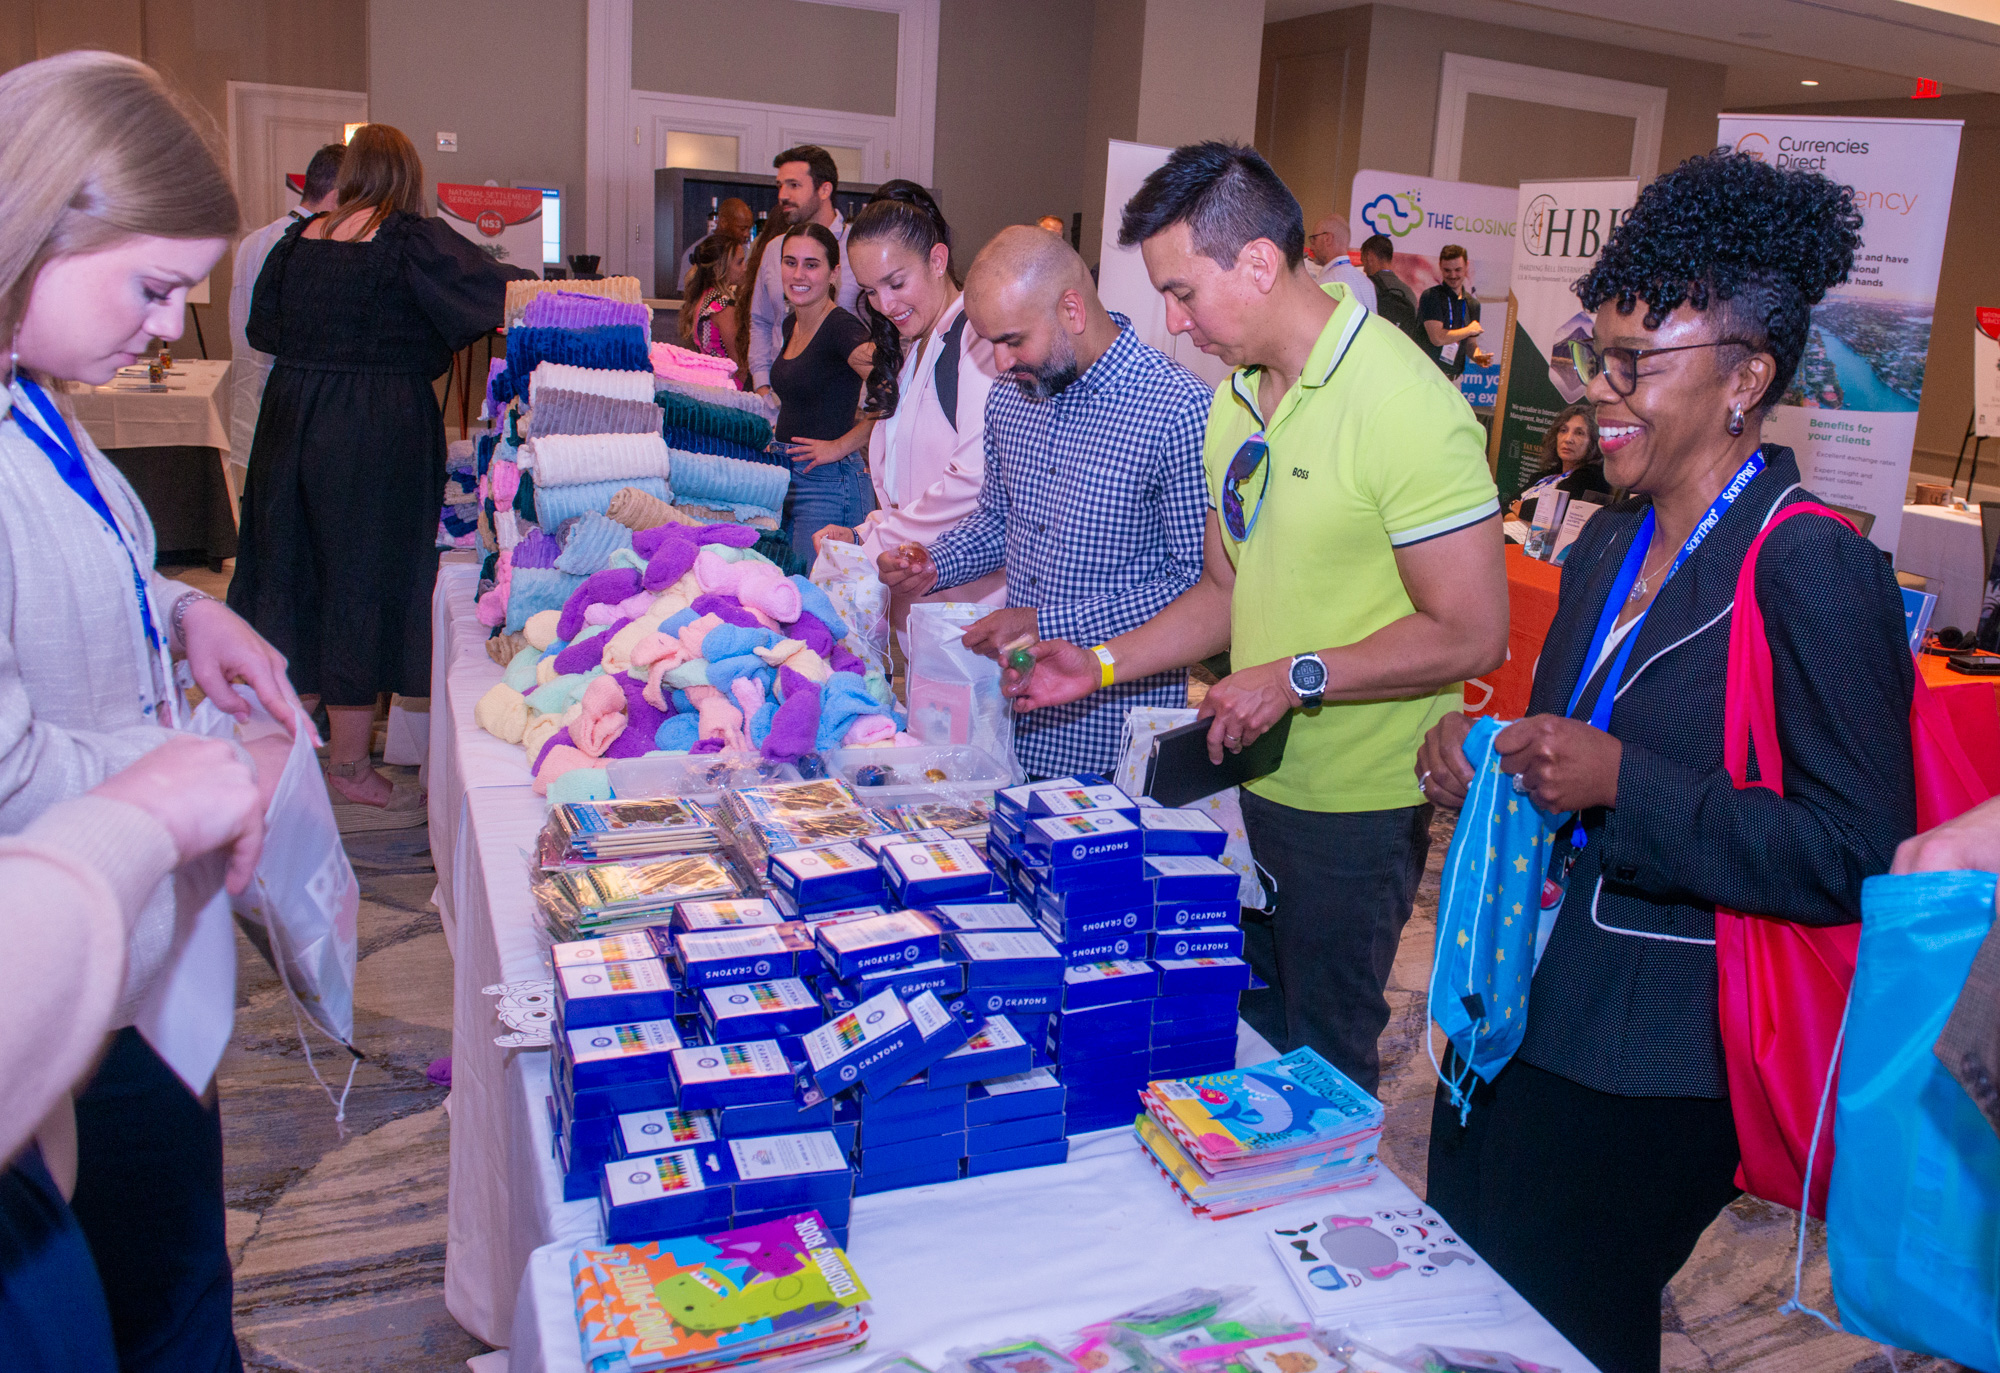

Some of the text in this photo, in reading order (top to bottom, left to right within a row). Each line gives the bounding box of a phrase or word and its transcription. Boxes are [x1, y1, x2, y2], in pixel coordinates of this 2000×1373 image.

[1779, 136, 1869, 154] Currencies
[1776, 153, 1827, 170] Direct
[448, 188, 484, 198] NATIONAL
[486, 190, 532, 200] SETTLEMENT
[448, 196, 482, 205] SERVICES
[484, 197, 513, 207] SUMMIT
[1852, 190, 1918, 215] ency
[481, 219, 501, 229] NS3
[1865, 253, 1883, 262] and
[1885, 254, 1909, 264] have
[1855, 278, 1884, 287] hands
[1460, 374, 1500, 389] orm yo
[1809, 418, 1873, 433] Benefits for
[1808, 432, 1871, 446] your clients
[1816, 450, 1896, 467] Excellent exchange rates
[1292, 467, 1309, 480] BOSS
[1814, 466, 1836, 476] Expert
[1837, 469, 1859, 480] insight
[1812, 475, 1863, 487] market updates
[1088, 841, 1130, 855] CRAYONS
[1190, 911, 1227, 921] CRAYONS
[1082, 918, 1122, 932] CRAYONS
[1072, 945, 1113, 958] CRAYONS
[1191, 942, 1229, 952] CRAYONS
[858, 951, 902, 968] CRAYONS
[705, 966, 752, 979] CRAYONS
[781, 981, 802, 1006] CRAYONS
[901, 979, 946, 994] CRAYONS
[1005, 996, 1047, 1006] CRAYONS
[816, 1032, 834, 1060] CRAYONS
[755, 1044, 773, 1072] CRAYONS
[858, 1039, 904, 1070] CRAYONS
[793, 1216, 858, 1299] COLORING BOOK
